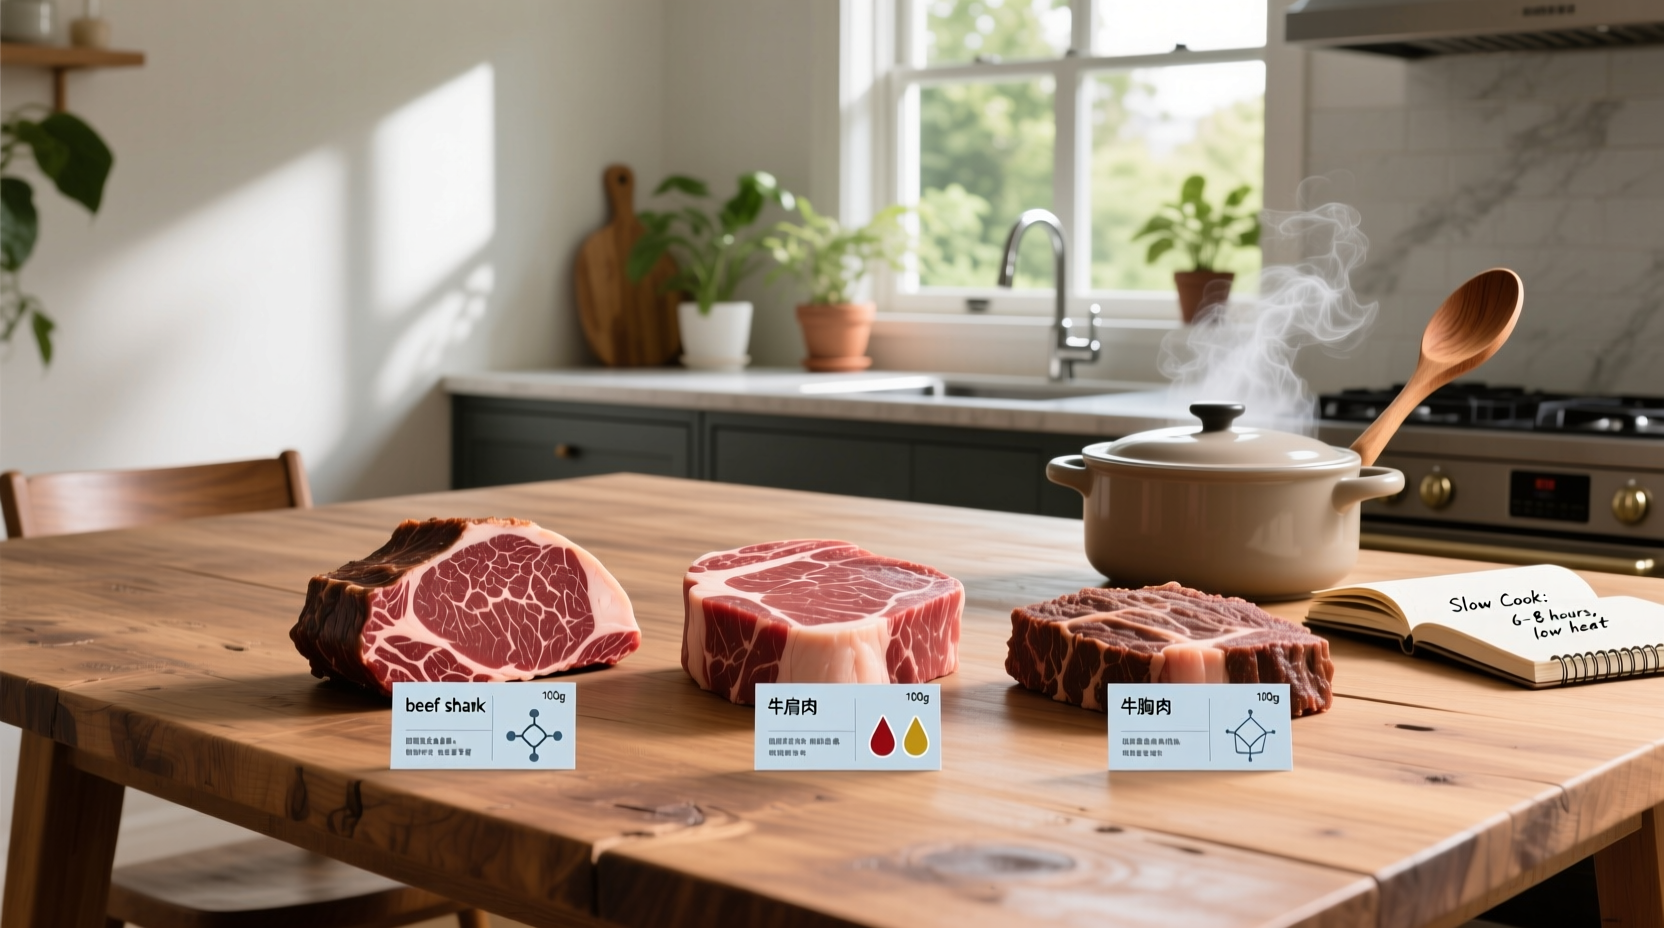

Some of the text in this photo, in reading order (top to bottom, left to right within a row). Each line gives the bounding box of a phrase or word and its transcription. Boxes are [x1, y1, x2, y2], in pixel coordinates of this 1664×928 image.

[1449, 590, 1548, 613] Slow Cook:
[1512, 610, 1545, 626] 6-8
[1533, 616, 1609, 640] low heat
[405, 697, 441, 713] beef
[542, 690, 566, 704] 100g
[906, 692, 930, 705] 100g
[1256, 692, 1280, 705] 100g
[767, 697, 818, 716] 牛肩肉
[1120, 697, 1172, 716] 牛胸肉
